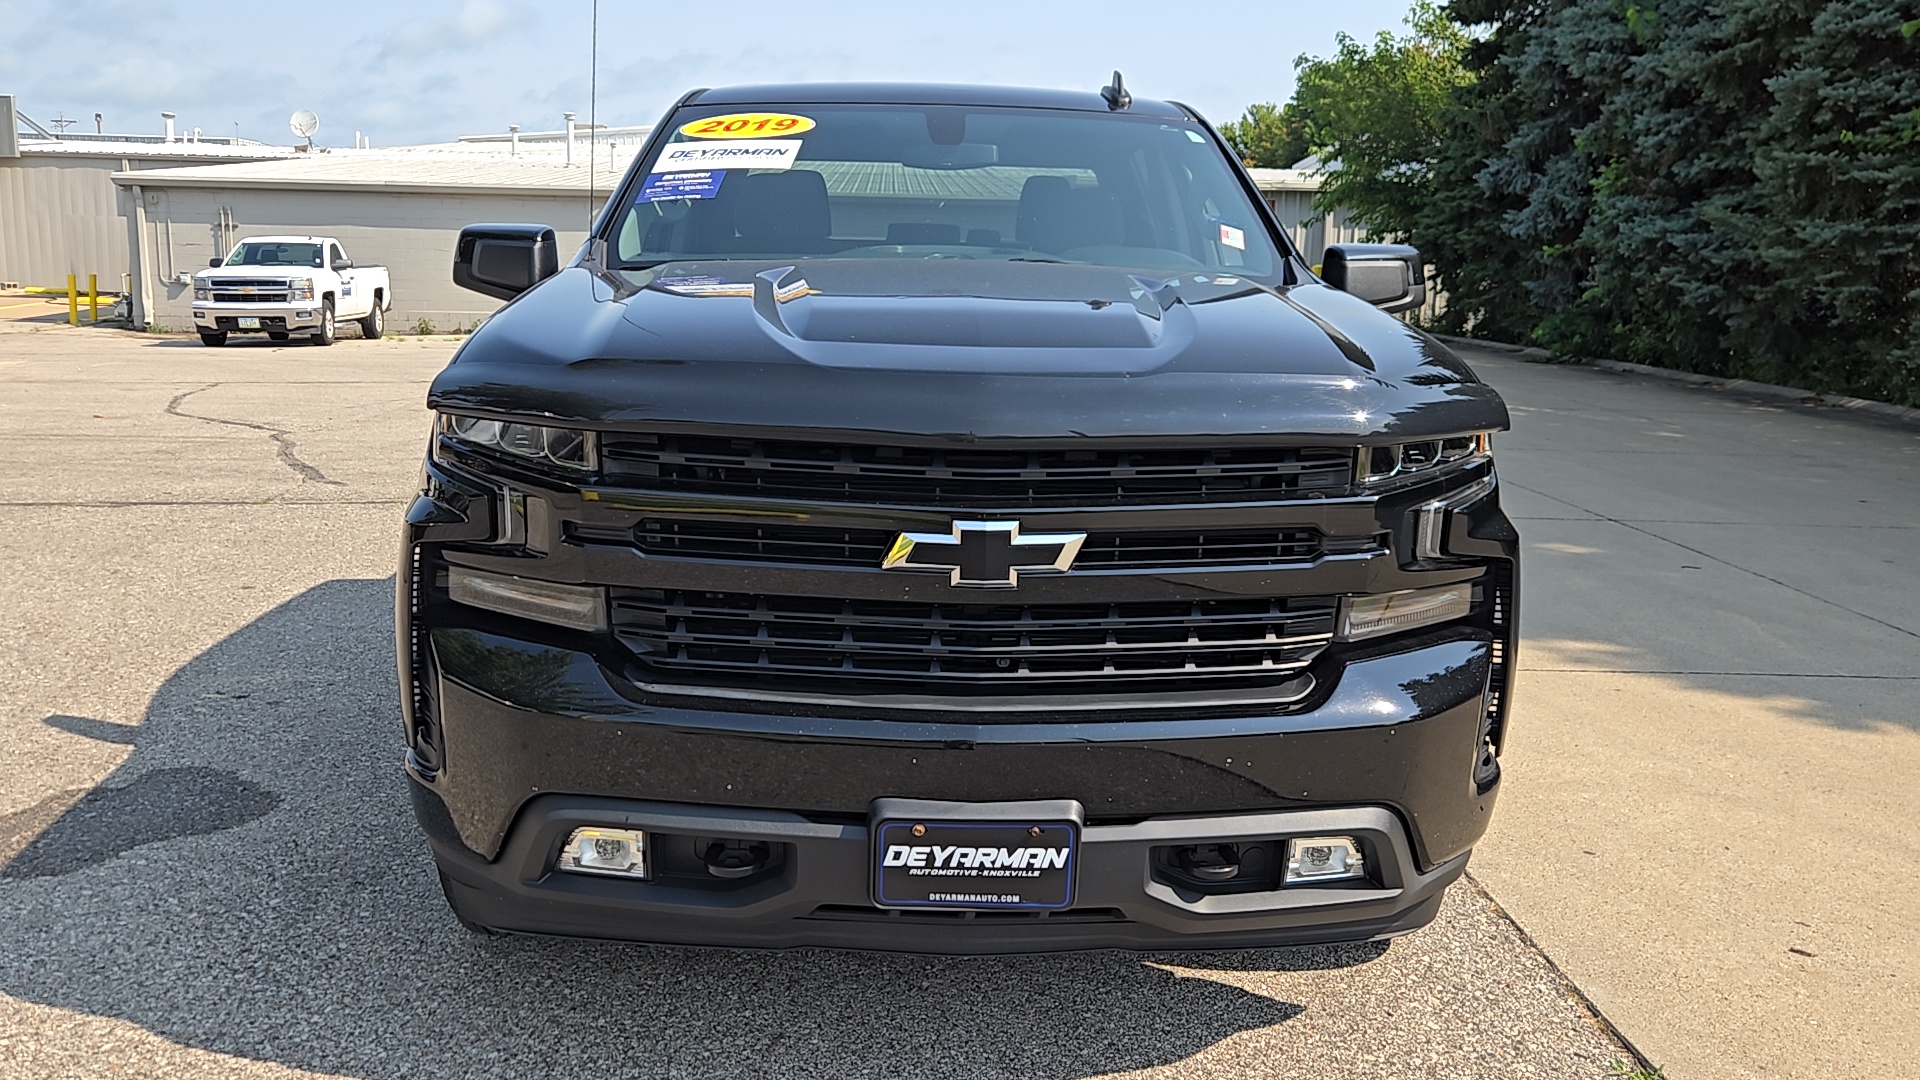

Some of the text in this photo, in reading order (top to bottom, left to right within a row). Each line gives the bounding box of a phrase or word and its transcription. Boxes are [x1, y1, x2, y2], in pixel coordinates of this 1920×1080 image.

[694, 119, 799, 133] 2019
[668, 148, 789, 159] DEYARMAN
[882, 845, 1070, 869] DEYARMAN
[909, 868, 1041, 877] AUTOMOTIVE-KNOXVILLE
[929, 893, 1020, 903] DEYARMANAUTO.COM
